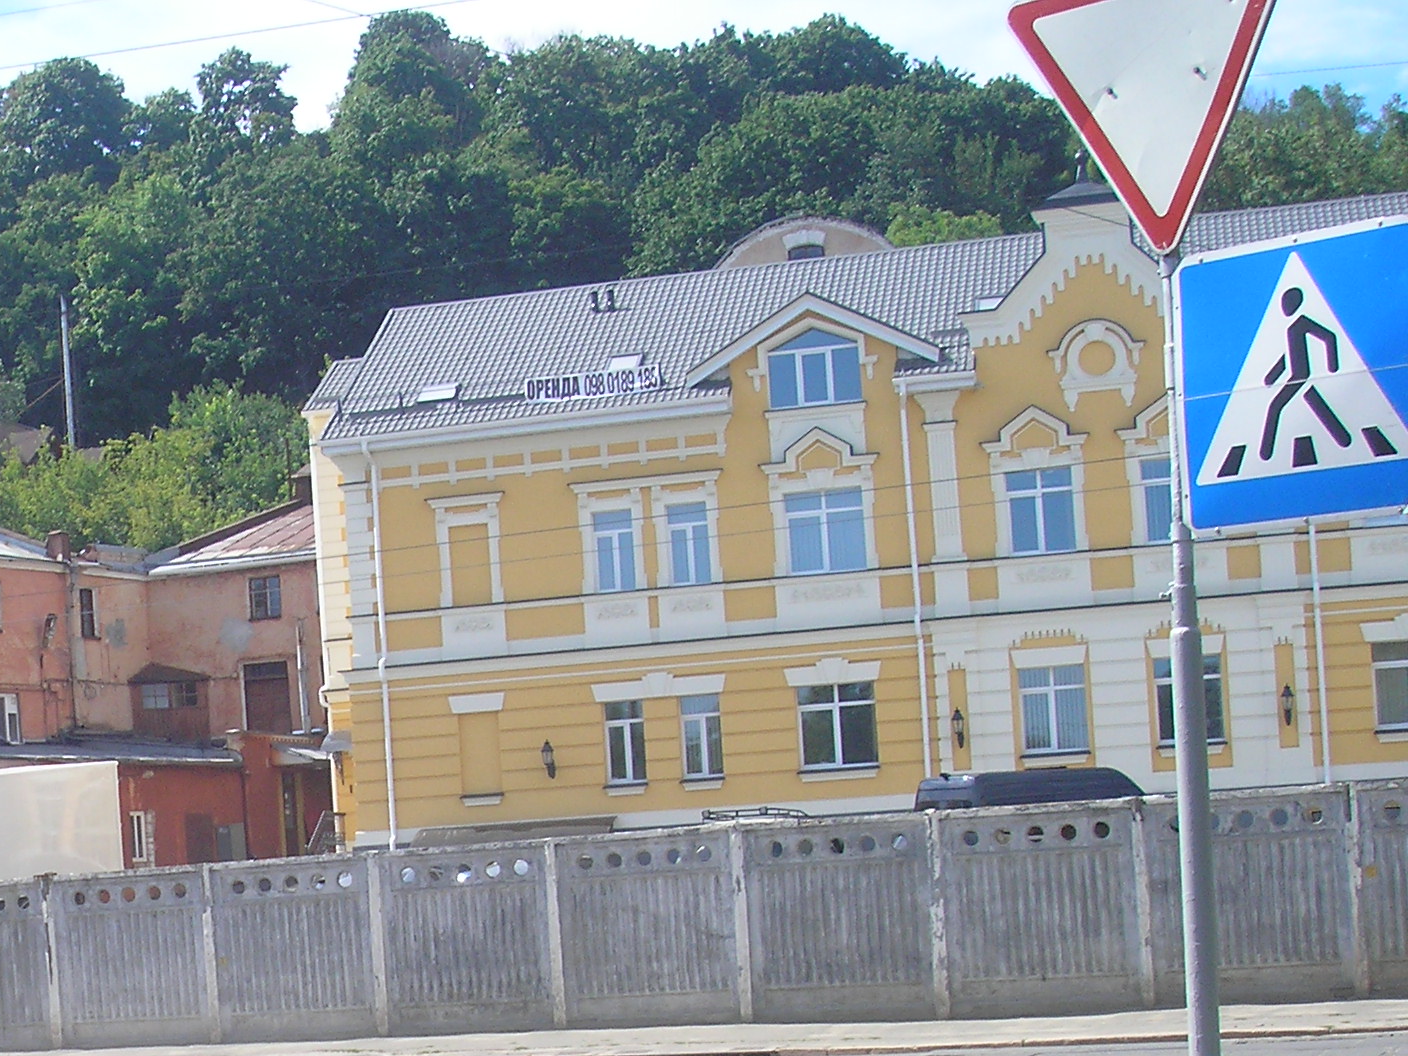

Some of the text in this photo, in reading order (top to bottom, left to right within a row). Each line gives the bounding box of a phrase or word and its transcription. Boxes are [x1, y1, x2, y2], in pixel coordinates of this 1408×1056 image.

[527, 376, 580, 400] ОРЕНДА
[584, 372, 605, 396] 098
[607, 370, 635, 393] 0189
